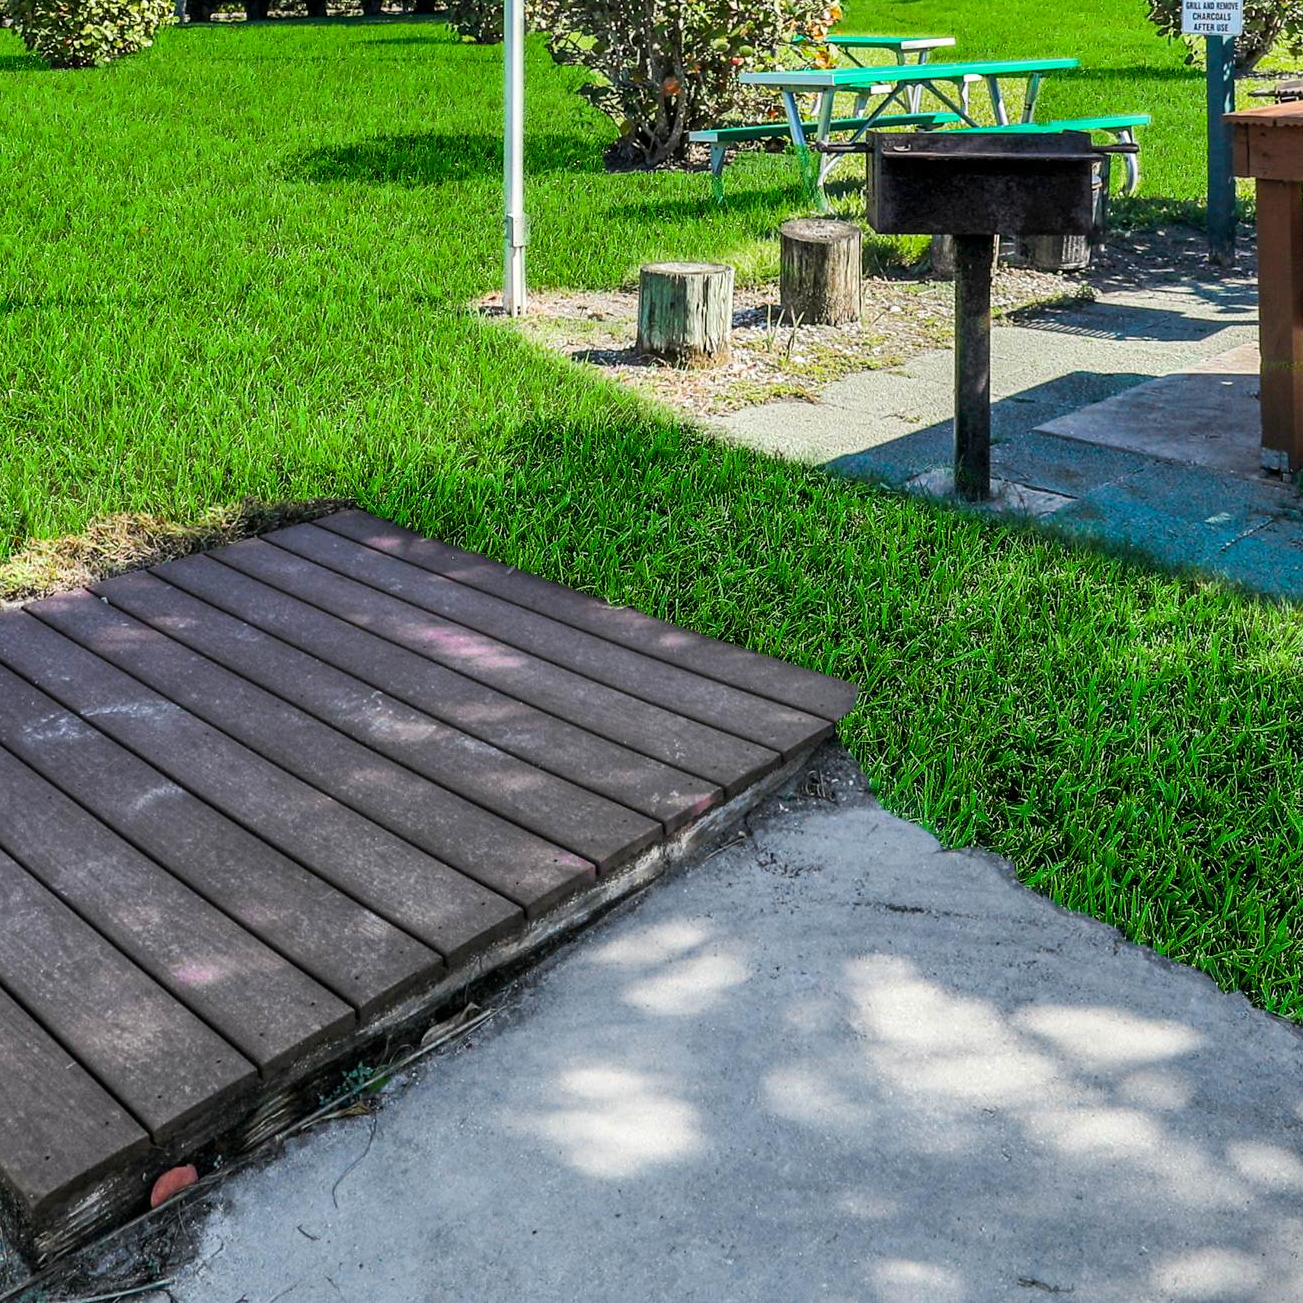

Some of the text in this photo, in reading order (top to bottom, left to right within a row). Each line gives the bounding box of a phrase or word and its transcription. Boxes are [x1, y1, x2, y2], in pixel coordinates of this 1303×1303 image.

[1186, 1, 1239, 10] GRILL AND REMOVE
[1192, 12, 1232, 21] CHARCOALS
[1193, 23, 1229, 32] AFTER USE
